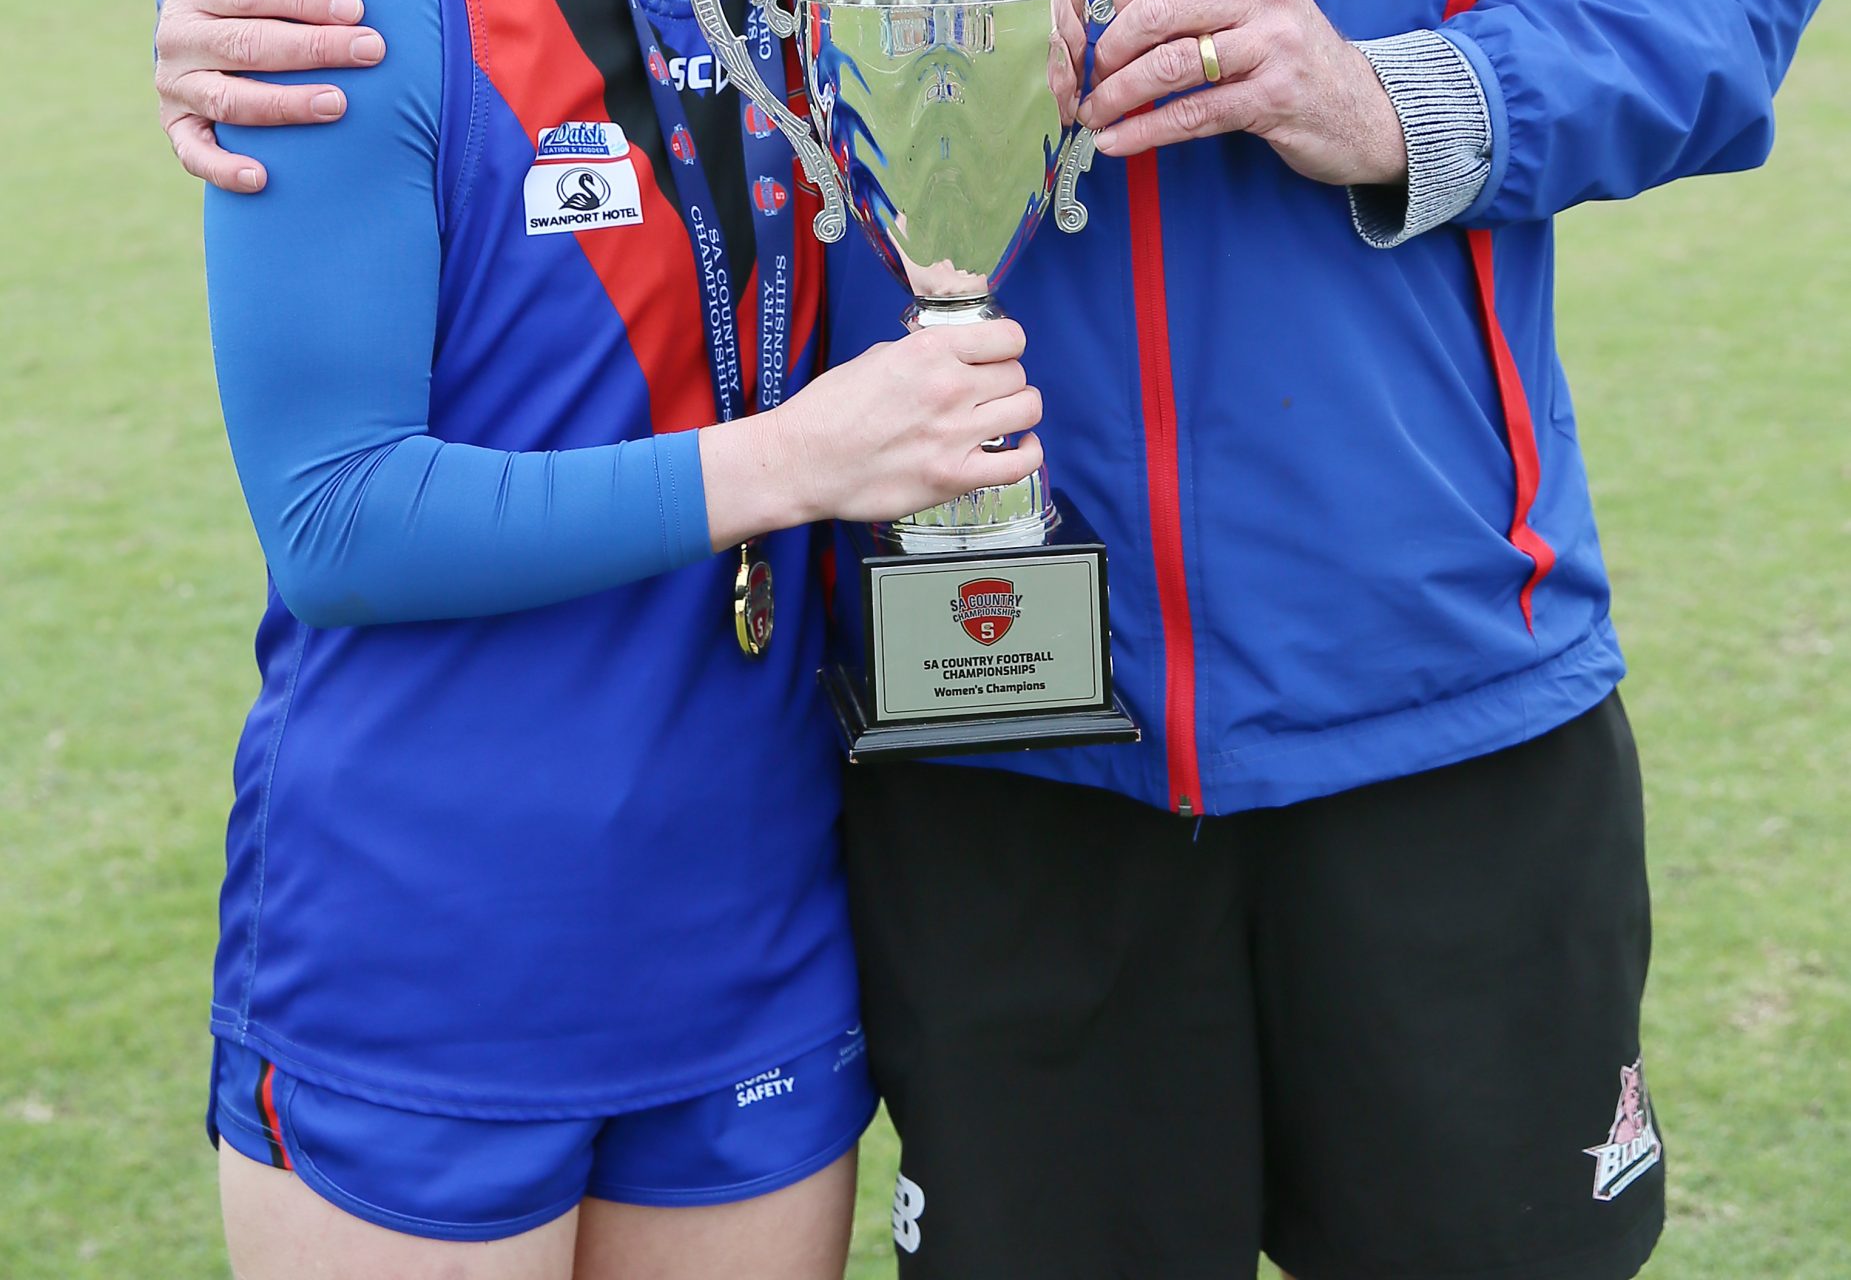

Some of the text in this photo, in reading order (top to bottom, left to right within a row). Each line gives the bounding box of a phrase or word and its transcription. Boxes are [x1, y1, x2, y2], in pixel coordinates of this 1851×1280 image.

[668, 54, 713, 92] SC
[551, 121, 607, 145] Daish
[530, 207, 639, 229] SWANPORT HOTEL
[690, 205, 733, 422] CHAMPIONSHIPS
[708, 228, 740, 392] SA COUNTRY
[763, 280, 774, 406] COUNTRY
[950, 593, 1023, 613] SA COUNTRY
[952, 607, 1022, 623] CHAMPIONSHIPS
[923, 651, 1054, 670] SA COUNTRY FOOTBALL
[943, 664, 1036, 680] CHAMPIONSHIPS
[934, 681, 1046, 698] Women's Champions
[736, 1076, 795, 1108] SAFETY
